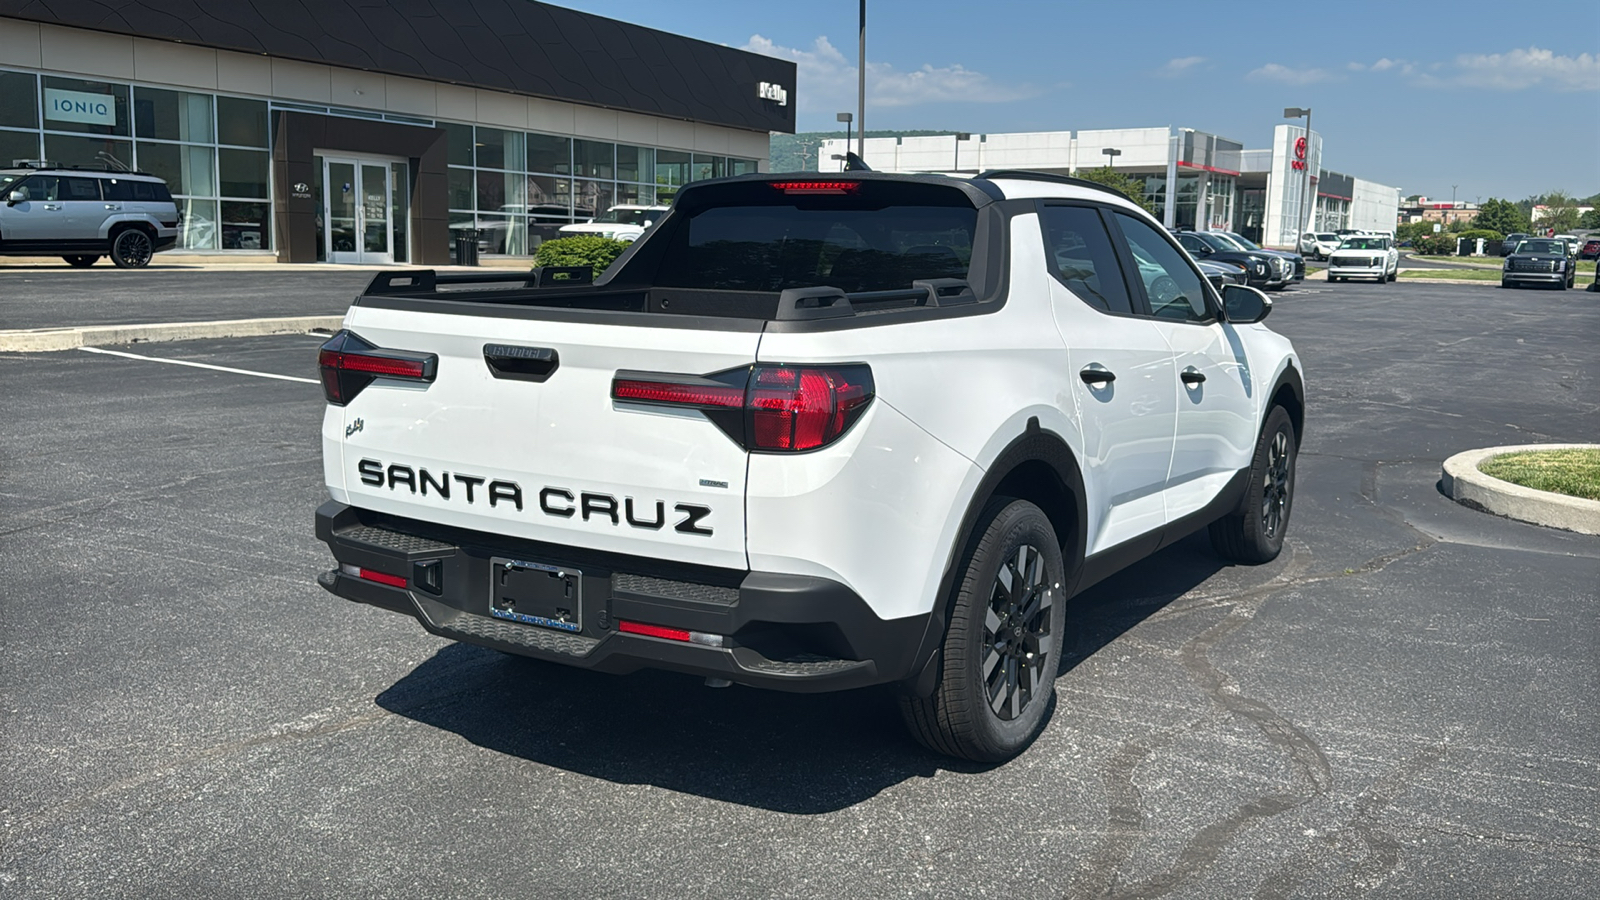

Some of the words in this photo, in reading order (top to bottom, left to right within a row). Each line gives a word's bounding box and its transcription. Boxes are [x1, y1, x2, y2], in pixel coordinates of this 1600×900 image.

[758, 81, 787, 106] Kelly
[54, 98, 107, 116] IONIQ
[492, 346, 540, 359] HYUNDAI
[358, 456, 524, 513] SANTA
[538, 485, 715, 538] CRUZ
